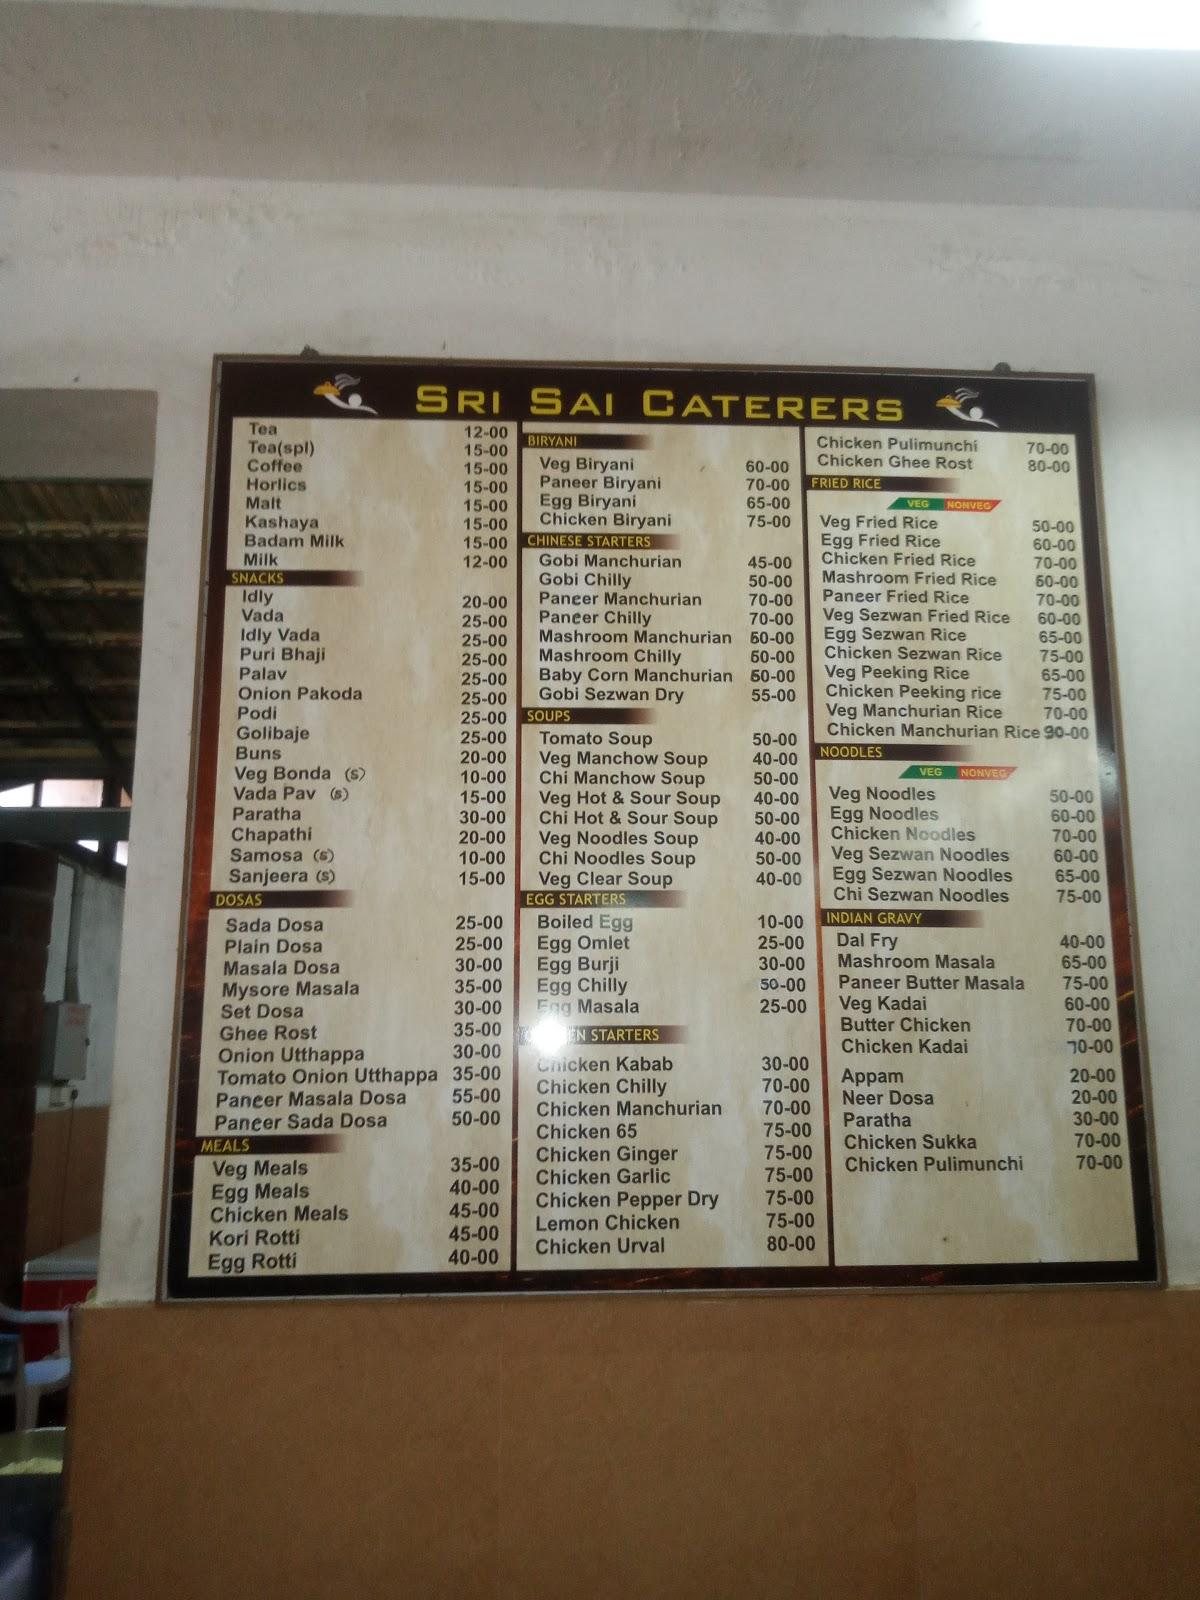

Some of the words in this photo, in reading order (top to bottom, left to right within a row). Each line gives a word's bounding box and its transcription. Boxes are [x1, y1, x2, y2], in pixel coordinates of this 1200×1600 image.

[248, 422, 278, 437] Tea
[464, 425, 508, 440] 12-00
[528, 436, 577, 447] BIRYANI
[247, 458, 303, 474] Coffee
[464, 462, 508, 476] 15-00
[539, 456, 570, 474] Veg
[576, 457, 634, 474] Biryani
[745, 460, 790, 473] 60-00
[817, 453, 883, 468] Chicken
[888, 454, 931, 469] Ghee
[935, 456, 973, 470] Rost
[1027, 459, 1071, 473] 80-00
[246, 477, 307, 493] Horlics
[464, 480, 508, 494] 15-00
[811, 478, 848, 488] FRIED
[853, 478, 881, 489] RICE
[907, 500, 928, 508] VEG
[946, 500, 992, 510] NONVEG
[245, 514, 319, 532] Kashaya
[464, 517, 508, 531] 15-00
[539, 511, 607, 526] Chicken
[613, 512, 672, 530] Biryani
[747, 514, 791, 528] 75-00
[244, 533, 304, 548] Badam
[310, 533, 345, 548] Milk
[463, 535, 508, 550] 15-00
[528, 536, 582, 546] CHINESE
[587, 536, 651, 547] STARTERS
[821, 533, 853, 550] Egg
[858, 533, 900, 547] Fried
[905, 534, 941, 548] Rice
[1032, 538, 1076, 552] 60-00
[539, 553, 578, 567] Gobi
[584, 553, 682, 568] Manchurian
[747, 555, 792, 570] 45-00
[232, 572, 284, 584] SNACKS
[241, 627, 272, 646] Idly
[277, 627, 320, 642] Vada
[462, 633, 508, 648] 25-00
[824, 645, 892, 660] Chicken
[897, 646, 961, 661] Sezwan
[966, 647, 1002, 662] Rice
[1039, 649, 1084, 664] 75-00
[824, 664, 856, 682] Veg
[861, 665, 928, 683] Peeking
[933, 666, 970, 680] Rice
[1041, 668, 1085, 683] 65-00
[238, 686, 291, 701] Onion
[297, 686, 362, 701] Pakoda
[461, 691, 507, 706] 25-00
[539, 686, 579, 701] Gobi
[584, 686, 649, 701] Sezwan
[655, 687, 684, 705] Dry
[751, 688, 796, 702] 55-00
[527, 710, 571, 722] SOUPS
[236, 725, 310, 744] Golibaje
[460, 730, 507, 745] 25-00
[539, 731, 603, 745] Tomato
[608, 731, 653, 749] Soup
[752, 732, 798, 746] 50-00
[235, 745, 282, 761] Buns
[460, 750, 507, 765] 20-00
[539, 750, 571, 769] Veg
[577, 750, 659, 765] Manchow
[663, 751, 708, 769] Soup
[752, 751, 798, 766] 40-00
[820, 747, 882, 758] NOODLES
[920, 768, 943, 777] VEG
[960, 768, 1008, 778] NONVEG
[539, 810, 568, 825] Chi
[574, 810, 604, 825] Hot
[609, 810, 622, 825] &
[627, 810, 669, 825] Sour
[673, 810, 718, 829] Soup
[754, 811, 800, 826] 50-00
[231, 826, 312, 846] Chapathi
[458, 830, 506, 845] 20-00
[228, 868, 308, 887] Sanjeera
[459, 871, 505, 886] 15-00
[832, 866, 867, 885] Egg
[871, 866, 938, 882] Sezwan
[943, 867, 1013, 883] Noodles
[1055, 868, 1100, 884] 65-00
[215, 894, 262, 906] DOSAS
[526, 893, 554, 905] EGG
[560, 893, 626, 905] STARTERS
[827, 912, 874, 924] INDIAN
[877, 912, 922, 924] GRAVY
[225, 938, 270, 955] Plain
[276, 938, 323, 954] Dosa
[455, 936, 503, 951] 25-00
[537, 935, 572, 954] Egg
[577, 935, 630, 950] Omlet
[758, 935, 805, 950] 25-00
[836, 932, 865, 947] Dal
[870, 932, 899, 951] Fry
[1059, 934, 1105, 949] 40-00
[838, 953, 930, 969] Mashroom
[935, 954, 995, 969] Masala
[1061, 954, 1107, 970] 65-00
[219, 1025, 268, 1042] Ghee
[274, 1024, 318, 1041] Rost
[453, 1021, 502, 1038] 35-00
[840, 1016, 895, 1032] Butter
[900, 1017, 971, 1033] Chicken
[1065, 1017, 1112, 1033] 70-00
[591, 1029, 659, 1041] STARTERS
[217, 1070, 287, 1086] Tomato
[292, 1068, 348, 1085] Onion
[354, 1067, 438, 1087] Utthappa
[453, 1065, 501, 1082] 35-00
[841, 1067, 904, 1088] Appam
[1070, 1068, 1116, 1083] 20-00
[842, 1089, 884, 1106] Neer
[889, 1090, 934, 1106] Dosa
[1071, 1089, 1118, 1105] 20-00
[536, 1101, 610, 1117] Chicken
[616, 1100, 722, 1117] Manchurian
[763, 1099, 811, 1116] 70-00
[536, 1123, 610, 1140] Chicken
[616, 1123, 637, 1139] 65
[763, 1122, 812, 1138] 75-00
[201, 1139, 250, 1153] MEALS
[844, 1134, 917, 1150] Chicken
[922, 1133, 977, 1150] Sukka
[1074, 1132, 1121, 1148] 70-00
[212, 1160, 248, 1182] Veg
[254, 1159, 309, 1177] Meals
[450, 1156, 500, 1173] 35-00
[844, 1156, 918, 1173] Chicken
[923, 1155, 1023, 1172] Pulimunchi
[1076, 1154, 1123, 1170] 70-00
[536, 1191, 610, 1209] Chicken
[617, 1191, 682, 1211] Pepper
[688, 1190, 719, 1210] Dry
[765, 1189, 814, 1206] 75-00
[210, 1206, 287, 1224] Chicken
[294, 1204, 349, 1222] Meals
[449, 1201, 499, 1219] 45-00
[209, 1229, 249, 1247] Kori
[255, 1228, 300, 1246] Rotti
[448, 1225, 499, 1242] 45-00
[535, 1237, 611, 1255] Chicken
[617, 1237, 665, 1254] Urval
[767, 1235, 816, 1252] 80-00
